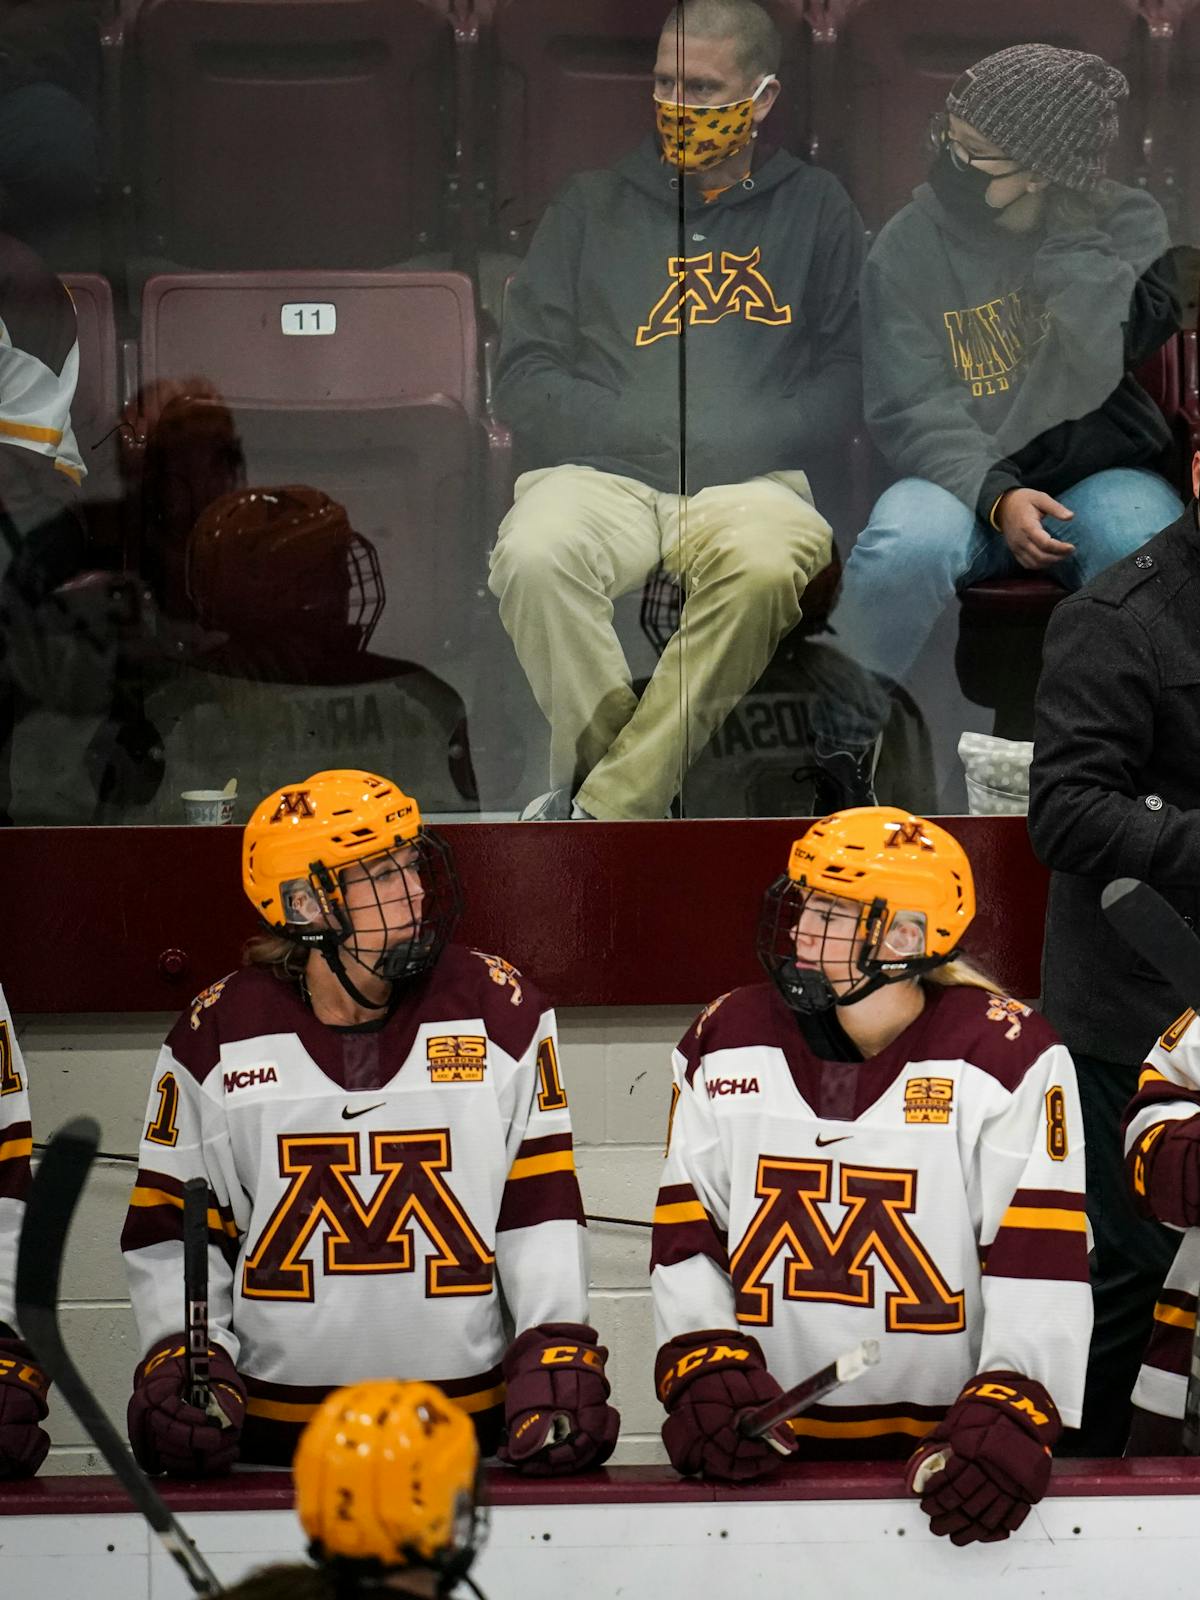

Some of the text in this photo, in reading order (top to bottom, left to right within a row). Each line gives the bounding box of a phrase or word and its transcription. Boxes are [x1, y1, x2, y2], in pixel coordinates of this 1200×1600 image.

[635, 246, 792, 346] M
[294, 309, 321, 331] 11
[270, 790, 316, 824] M
[385, 805, 413, 823] CCM
[884, 822, 936, 852] M
[880, 961, 908, 971] CCM
[427, 1036, 487, 1059] 25
[537, 1036, 568, 1112] 1
[905, 1078, 953, 1100] 25
[145, 1071, 179, 1148] 1
[1045, 1084, 1070, 1161] 8
[242, 1128, 496, 1302] M
[731, 1154, 967, 1335] M
